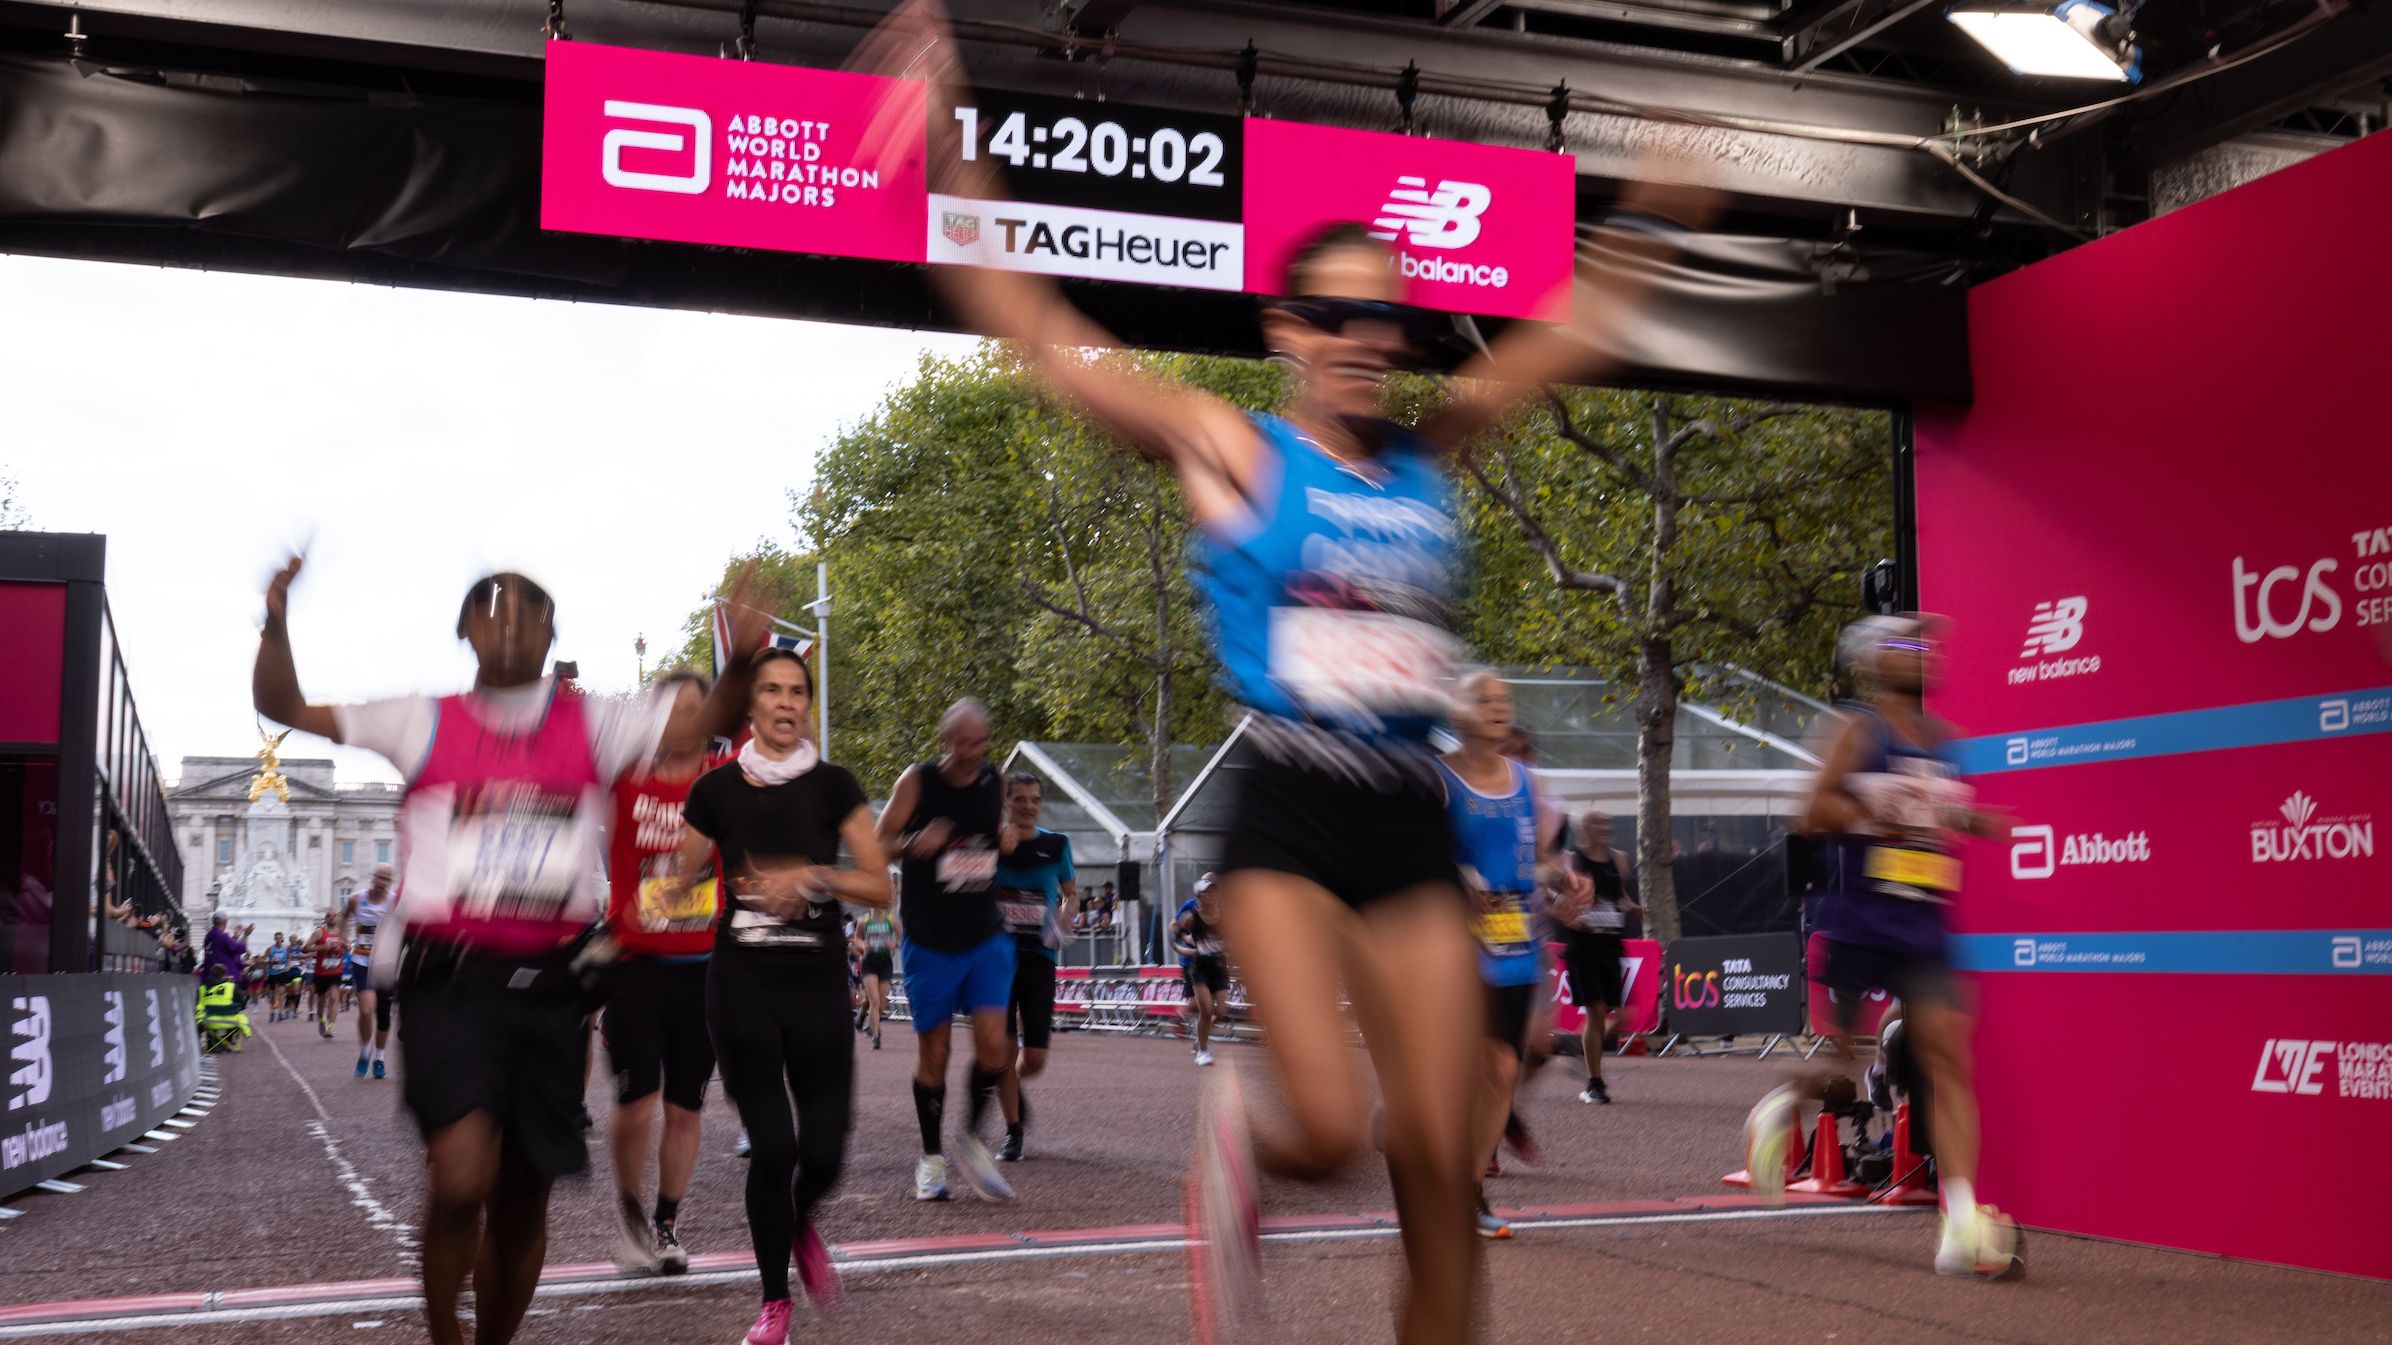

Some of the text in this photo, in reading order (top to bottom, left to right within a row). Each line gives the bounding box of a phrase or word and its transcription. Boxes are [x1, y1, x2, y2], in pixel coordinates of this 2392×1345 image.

[728, 113, 830, 142] ABBOTT
[727, 134, 821, 162] WORLD
[955, 106, 1225, 187] 14:20:02
[726, 156, 879, 190] MARATHON
[726, 178, 835, 208] MAJORS
[1401, 251, 1509, 288] balance
[2232, 555, 2343, 644] tcs
[2008, 655, 2101, 685] new balance
[2060, 830, 2151, 865] Abbott
[2251, 821, 2374, 863] BUXTON
[1722, 958, 1752, 974] TATA
[1674, 963, 1719, 1010] tcs
[1722, 974, 1790, 991] CONSULTANCY
[1723, 992, 1767, 1008] SERVICES
